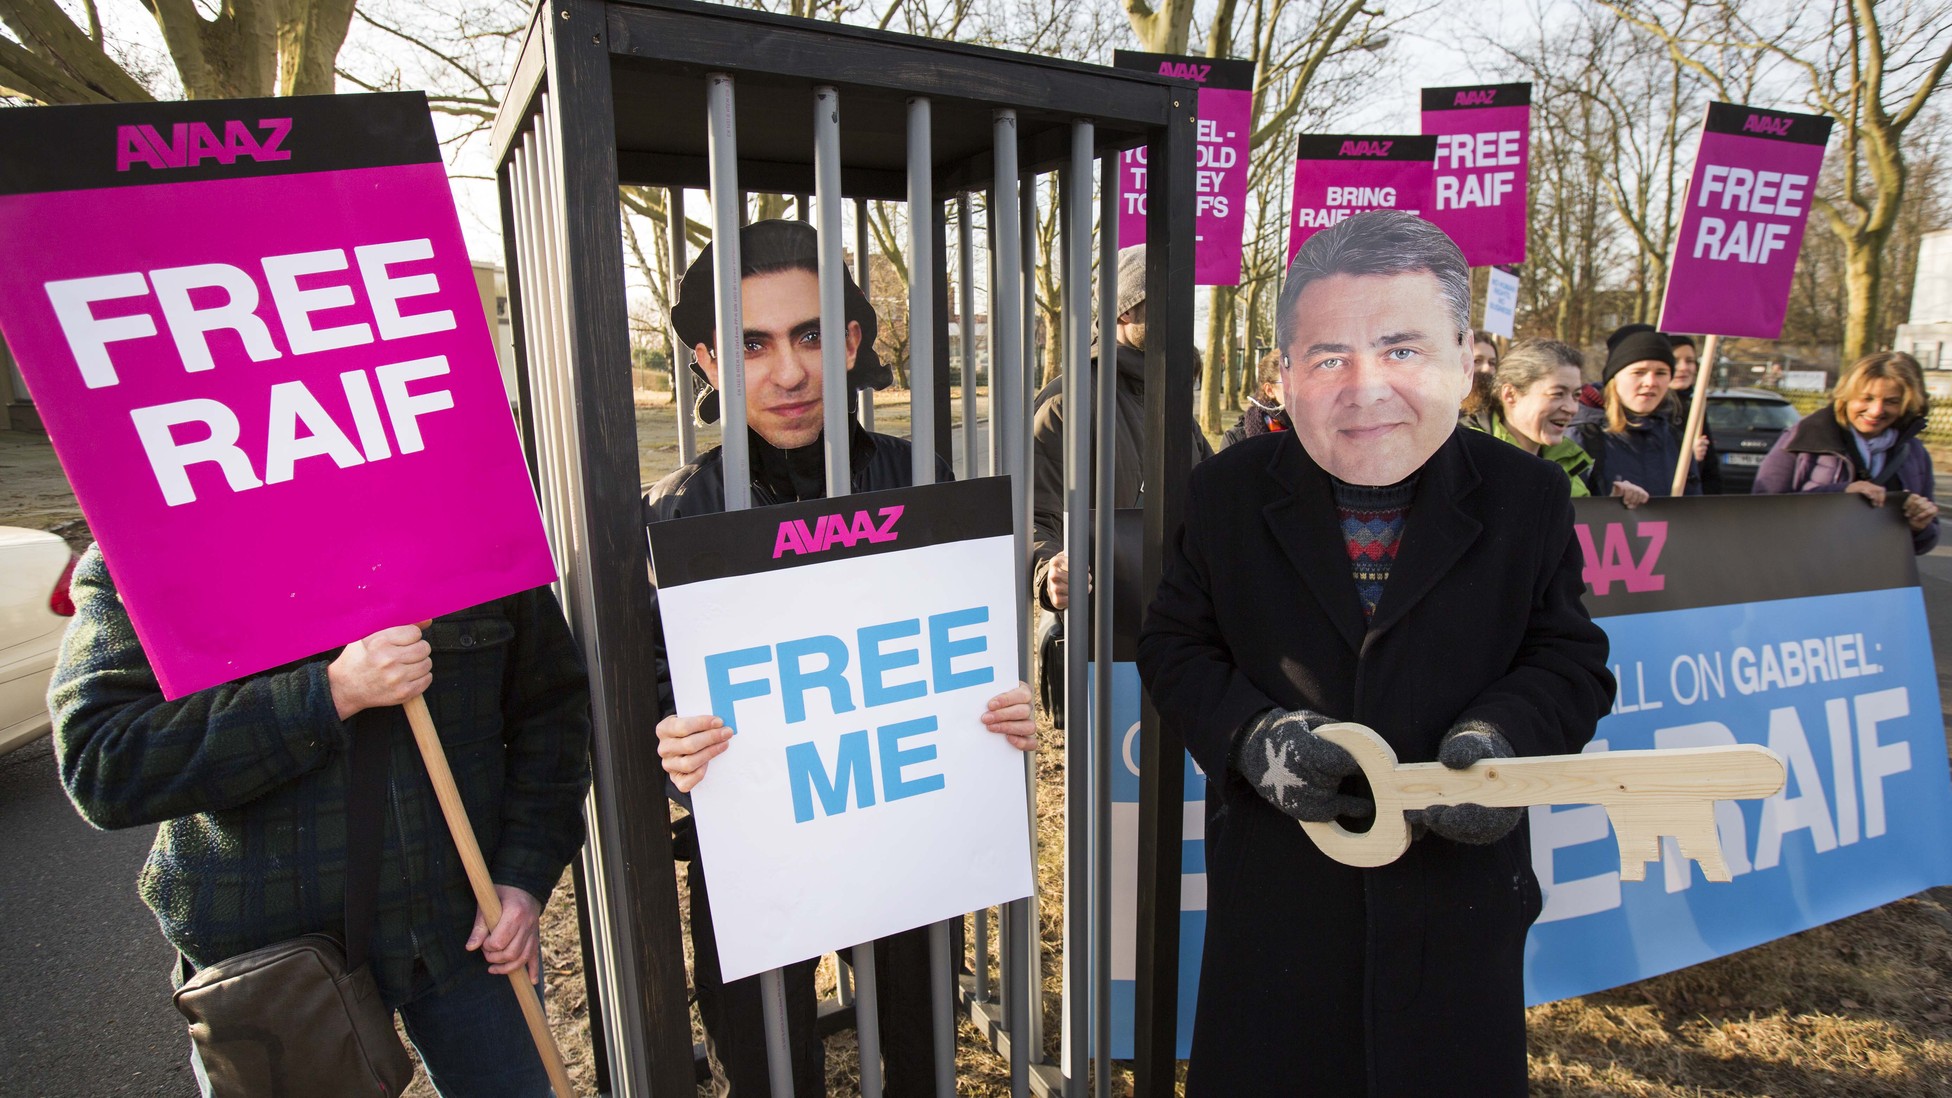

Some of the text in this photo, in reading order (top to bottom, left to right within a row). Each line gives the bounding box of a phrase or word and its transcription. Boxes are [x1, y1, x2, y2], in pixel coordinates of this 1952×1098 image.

[1158, 61, 1211, 82] AVAAZ
[1453, 90, 1497, 106] AVAAZ
[116, 117, 293, 172] AVAAZ
[1338, 140, 1394, 157] AVAAZ
[1743, 114, 1794, 137] AVAAZ
[1196, 147, 1236, 168] OLD
[1433, 130, 1521, 170] FREE
[1196, 171, 1225, 192] EY
[1326, 186, 1397, 207] BRING
[1436, 171, 1515, 210] RAIF
[1697, 164, 1809, 217] FREE
[1693, 216, 1791, 264] RAIF
[44, 238, 457, 389] FREE
[130, 355, 454, 507] RAIF
[772, 505, 905, 559] AVAAZ
[1574, 521, 1668, 596] AAZ
[704, 606, 995, 735] FREE
[1670, 652, 1726, 705] ON
[785, 715, 945, 824] ME
